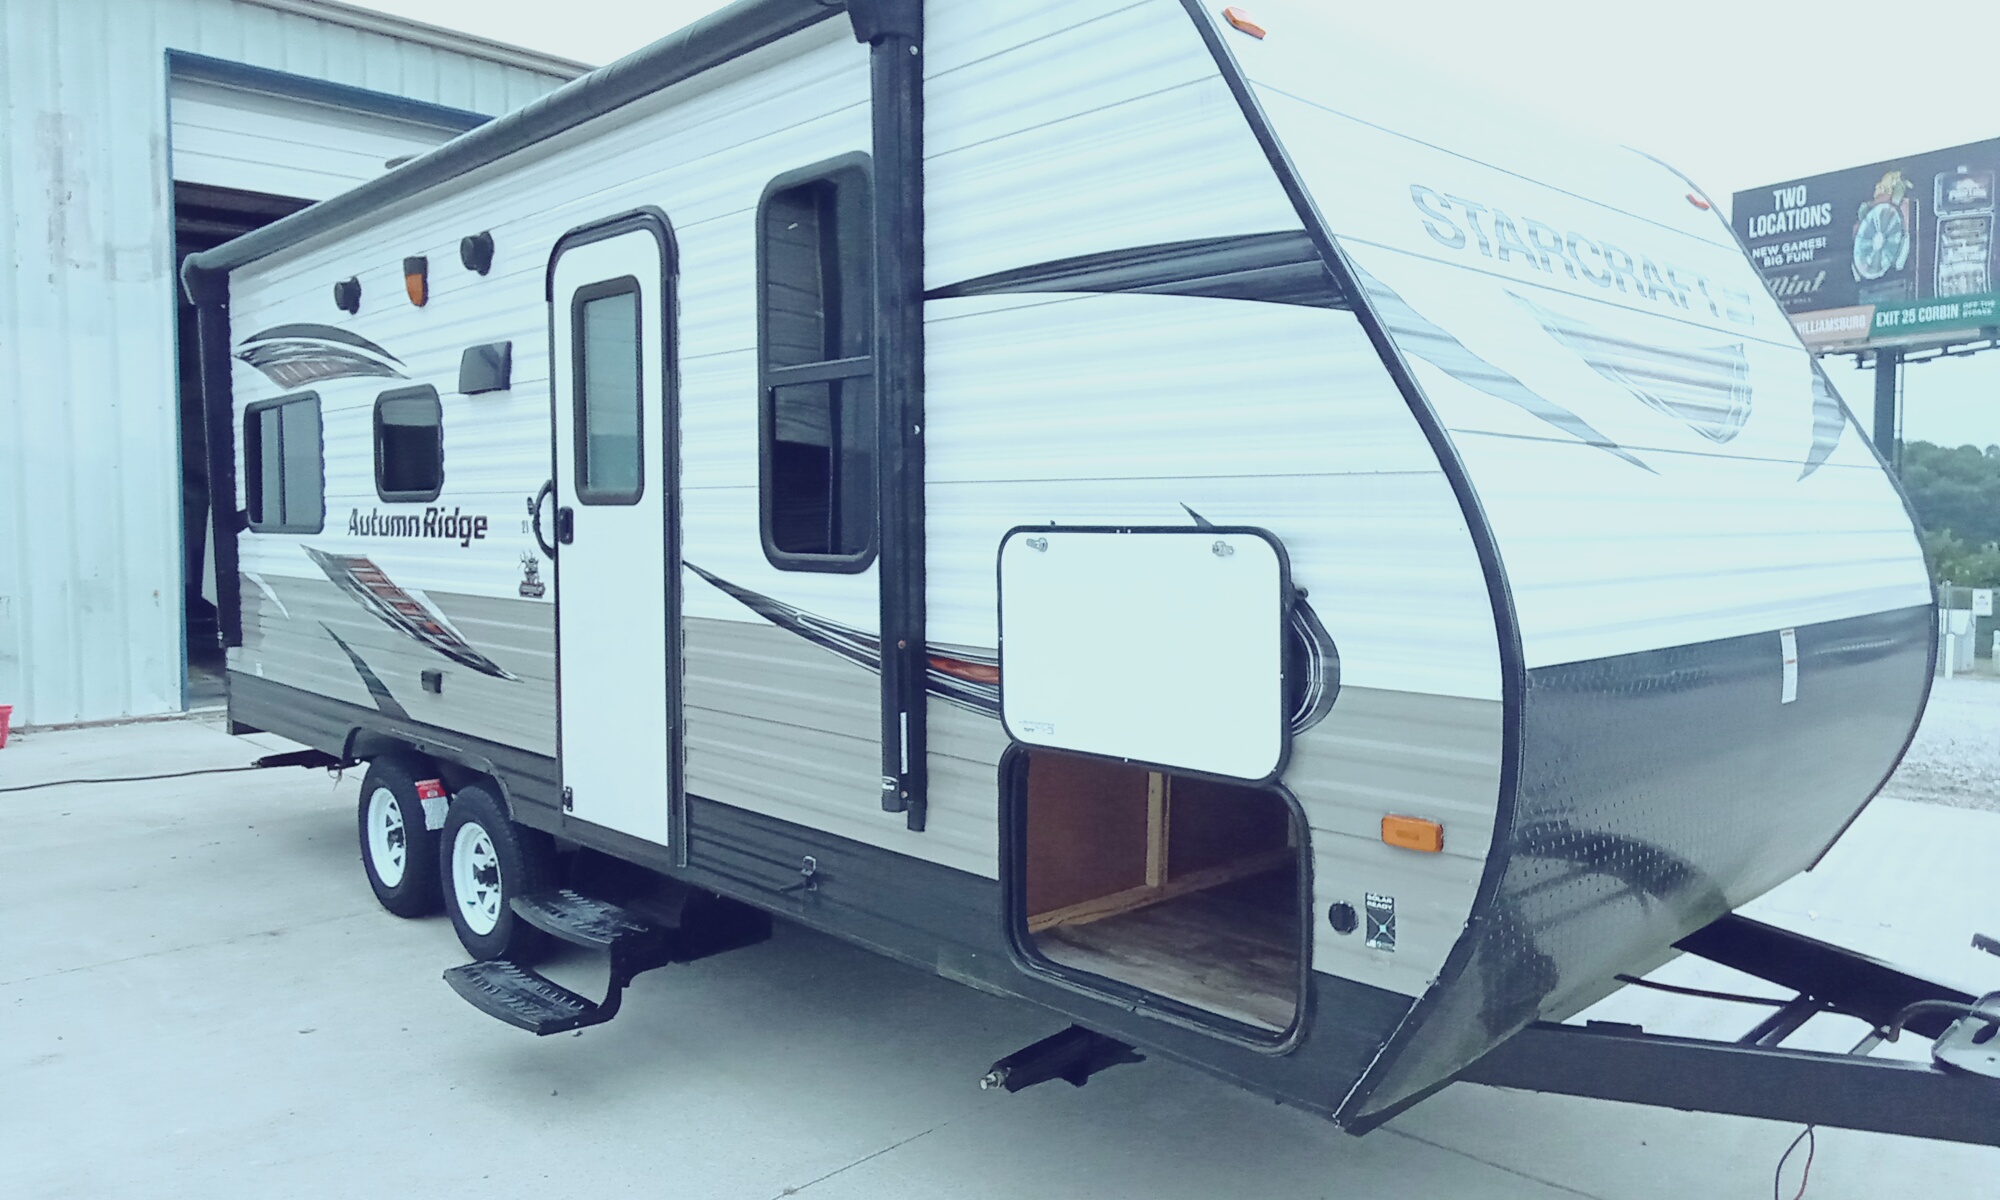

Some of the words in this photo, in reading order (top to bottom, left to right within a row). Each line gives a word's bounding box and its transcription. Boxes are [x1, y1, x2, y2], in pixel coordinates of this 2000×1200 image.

[1773, 185, 1807, 211] TWO
[1749, 203, 1832, 239] LOCATIONS
[1409, 184, 1719, 318] STARCRAFT
[1752, 244, 1780, 259] NEW
[1782, 236, 1827, 254] GAMES!
[1763, 254, 1784, 268] BIG
[1786, 250, 1814, 265] FUN!
[1876, 310, 1900, 328] EXIT
[1918, 304, 1959, 323] CORBIN
[348, 507, 420, 537] Autumn
[423, 506, 489, 548] Ridge
[1366, 900, 1393, 911] READY
